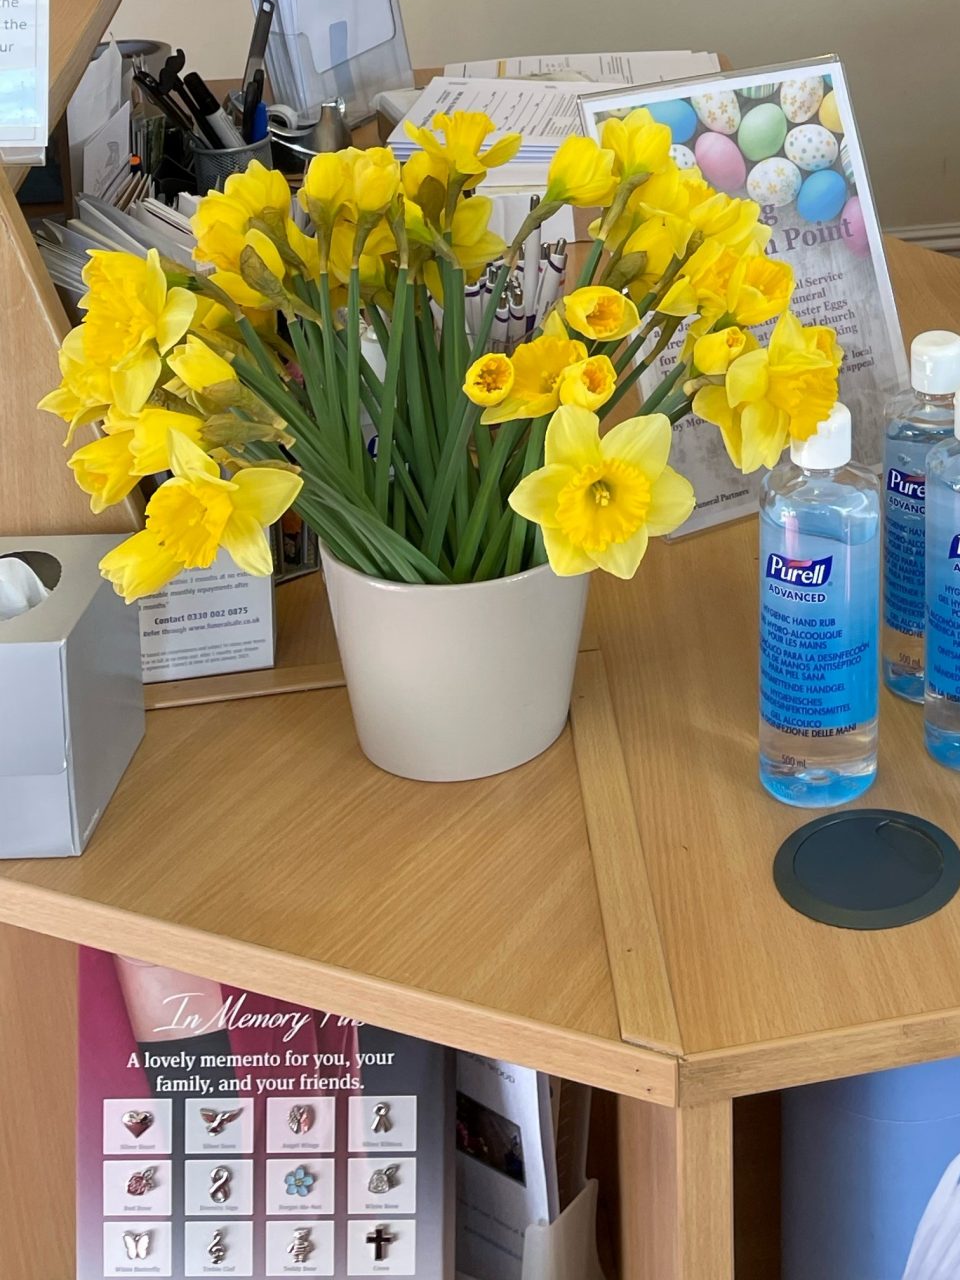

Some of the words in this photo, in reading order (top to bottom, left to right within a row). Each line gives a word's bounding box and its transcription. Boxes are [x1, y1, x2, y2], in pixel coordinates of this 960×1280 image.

[4, 19, 27, 30] the
[0, 43, 14, 52] ur
[782, 218, 854, 252] Point
[805, 272, 844, 287] Service
[792, 289, 827, 305] uneral
[791, 303, 822, 319] aster
[824, 298, 848, 312] Eggs
[820, 308, 856, 326] church
[835, 324, 859, 339] king
[852, 346, 873, 360] local
[846, 357, 875, 375] appeal
[890, 470, 925, 496] Pure
[694, 495, 720, 511] uneral
[720, 488, 749, 502] Partners
[888, 496, 925, 514] ADVANC
[771, 554, 826, 584] Purell
[768, 584, 826, 602] ADVANCED
[154, 614, 185, 626] Contact
[792, 618, 817, 628] HAND
[820, 618, 836, 627] RUB
[799, 640, 828, 650] MAINS
[802, 672, 826, 681] SANA
[806, 683, 845, 694] HANDGEL
[811, 728, 834, 738] DELLE
[835, 722, 857, 736] MANI
[153, 992, 202, 1033] In
[194, 993, 312, 1042] Memory
[127, 1054, 140, 1068] A
[144, 1051, 196, 1071] lovely
[200, 1052, 280, 1068] memento
[285, 1051, 309, 1066] for
[314, 1054, 350, 1070] you,
[354, 1052, 395, 1069] your
[156, 1076, 214, 1094] family,
[218, 1076, 252, 1092] and
[256, 1078, 295, 1094] your
[300, 1074, 365, 1090] friends.
